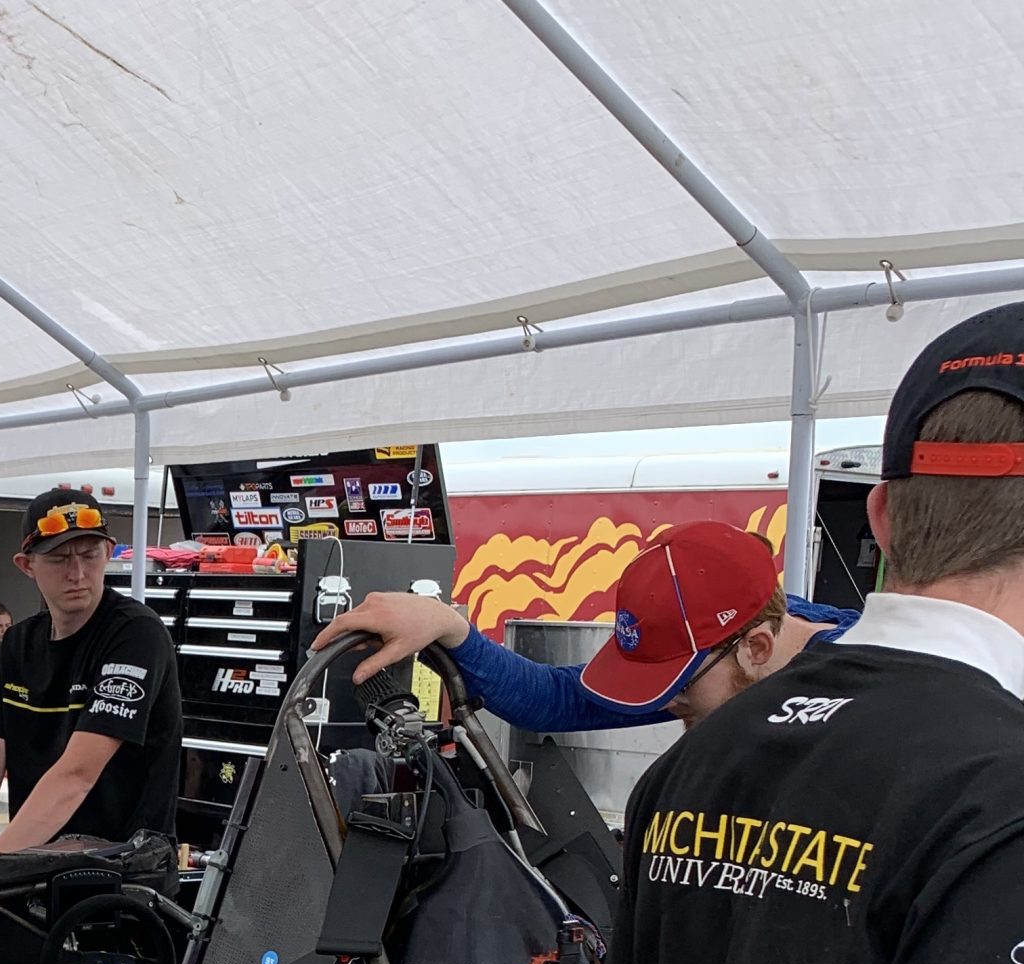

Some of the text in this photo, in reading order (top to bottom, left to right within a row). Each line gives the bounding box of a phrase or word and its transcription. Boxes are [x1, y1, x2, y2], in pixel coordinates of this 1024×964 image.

[939, 353, 1013, 374] Formula
[232, 494, 258, 502] MYLAPS
[309, 499, 334, 509] HPS
[235, 511, 280, 525] tilton
[349, 522, 373, 533] MoTeC
[616, 623, 639, 638] NASA
[89, 699, 138, 719] Hoosier
[767, 696, 854, 724] SR21
[760, 821, 874, 892] STATE
[796, 879, 827, 900] 1895.
